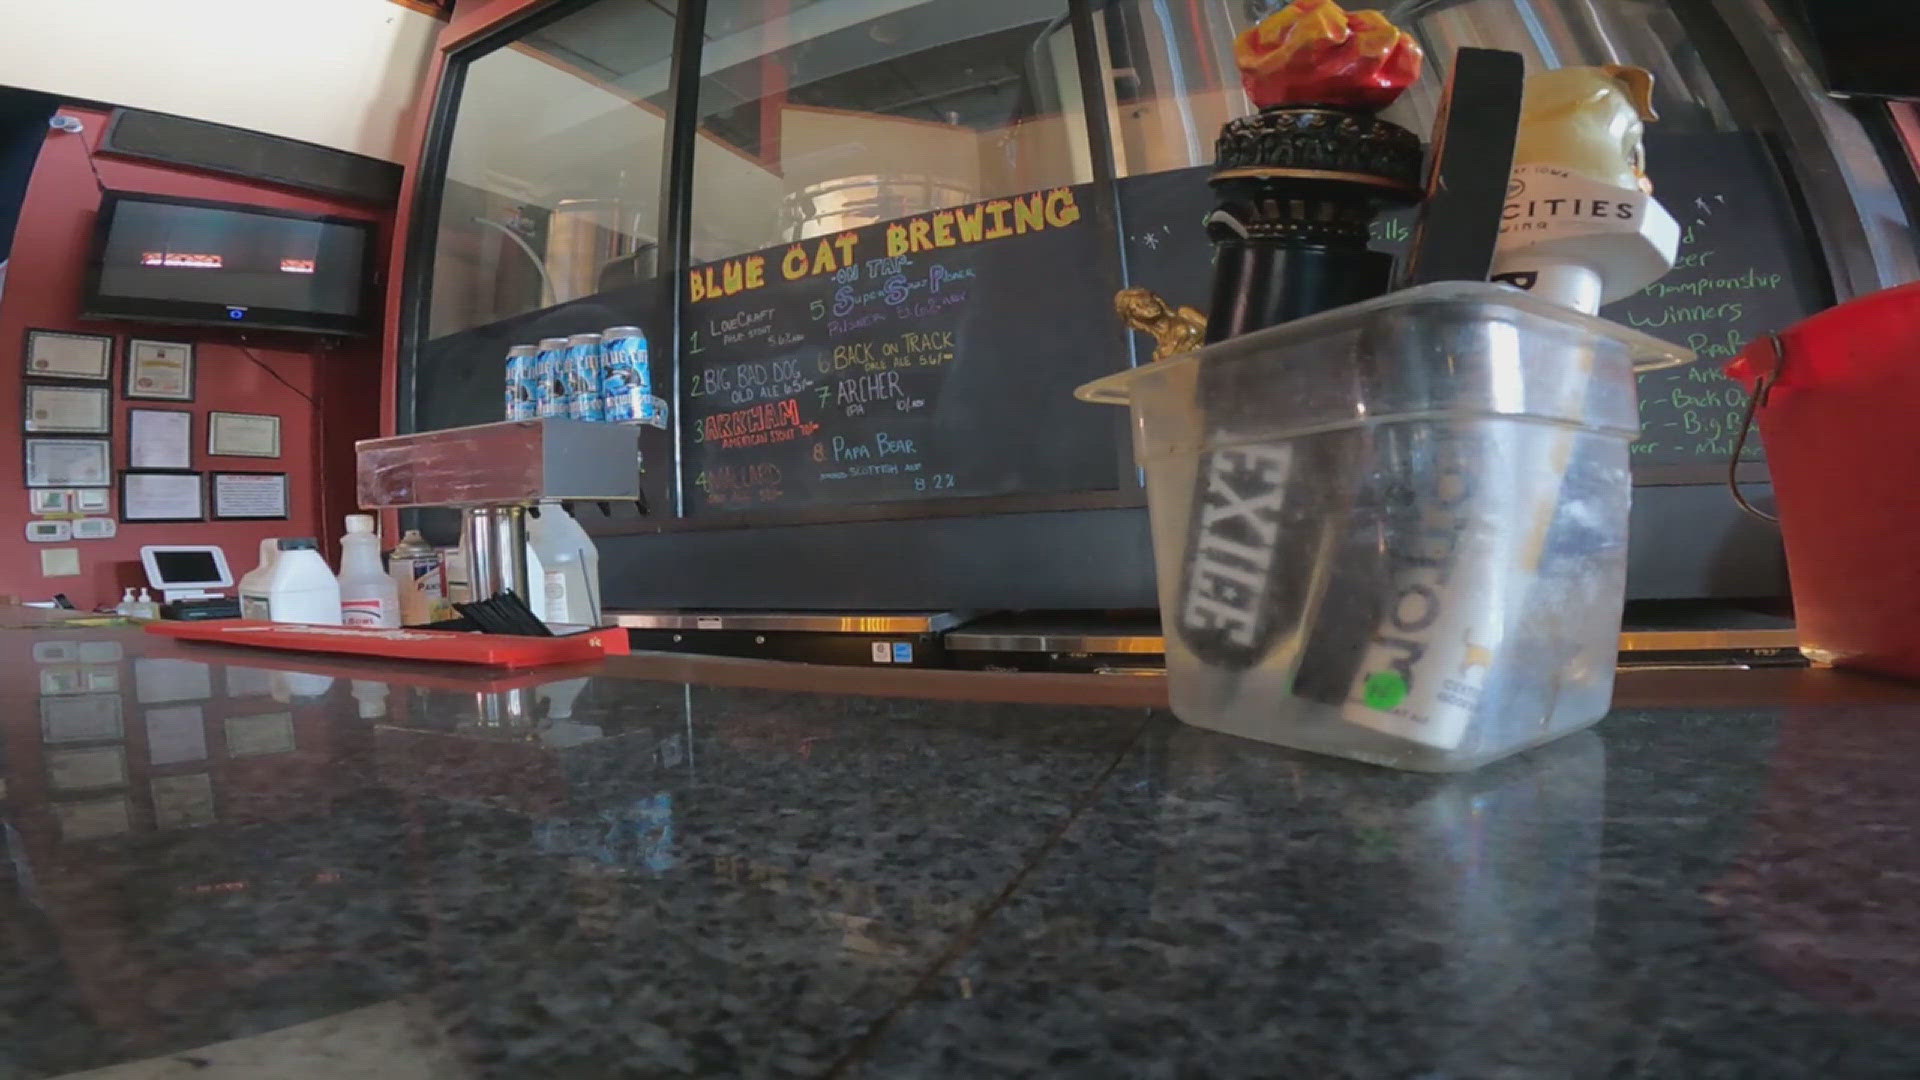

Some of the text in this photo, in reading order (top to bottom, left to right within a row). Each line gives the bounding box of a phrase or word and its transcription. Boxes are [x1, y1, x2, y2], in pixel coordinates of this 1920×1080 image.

[1503, 198, 1634, 220] CITIES
[690, 186, 1082, 303] BLUE CAT BREWING
[809, 300, 825, 321] 5
[690, 331, 706, 354] 1
[817, 331, 955, 373] 6 BACK ON TRACK
[691, 359, 801, 397] 2 BIG BAD DOG
[731, 387, 754, 404] OLD
[760, 385, 780, 398] ALE
[814, 370, 905, 408] 7 ARCHER
[694, 419, 704, 443] 3
[705, 398, 801, 441] ARKHAM
[812, 441, 826, 462] 8
[1184, 440, 1293, 648] EXILE
